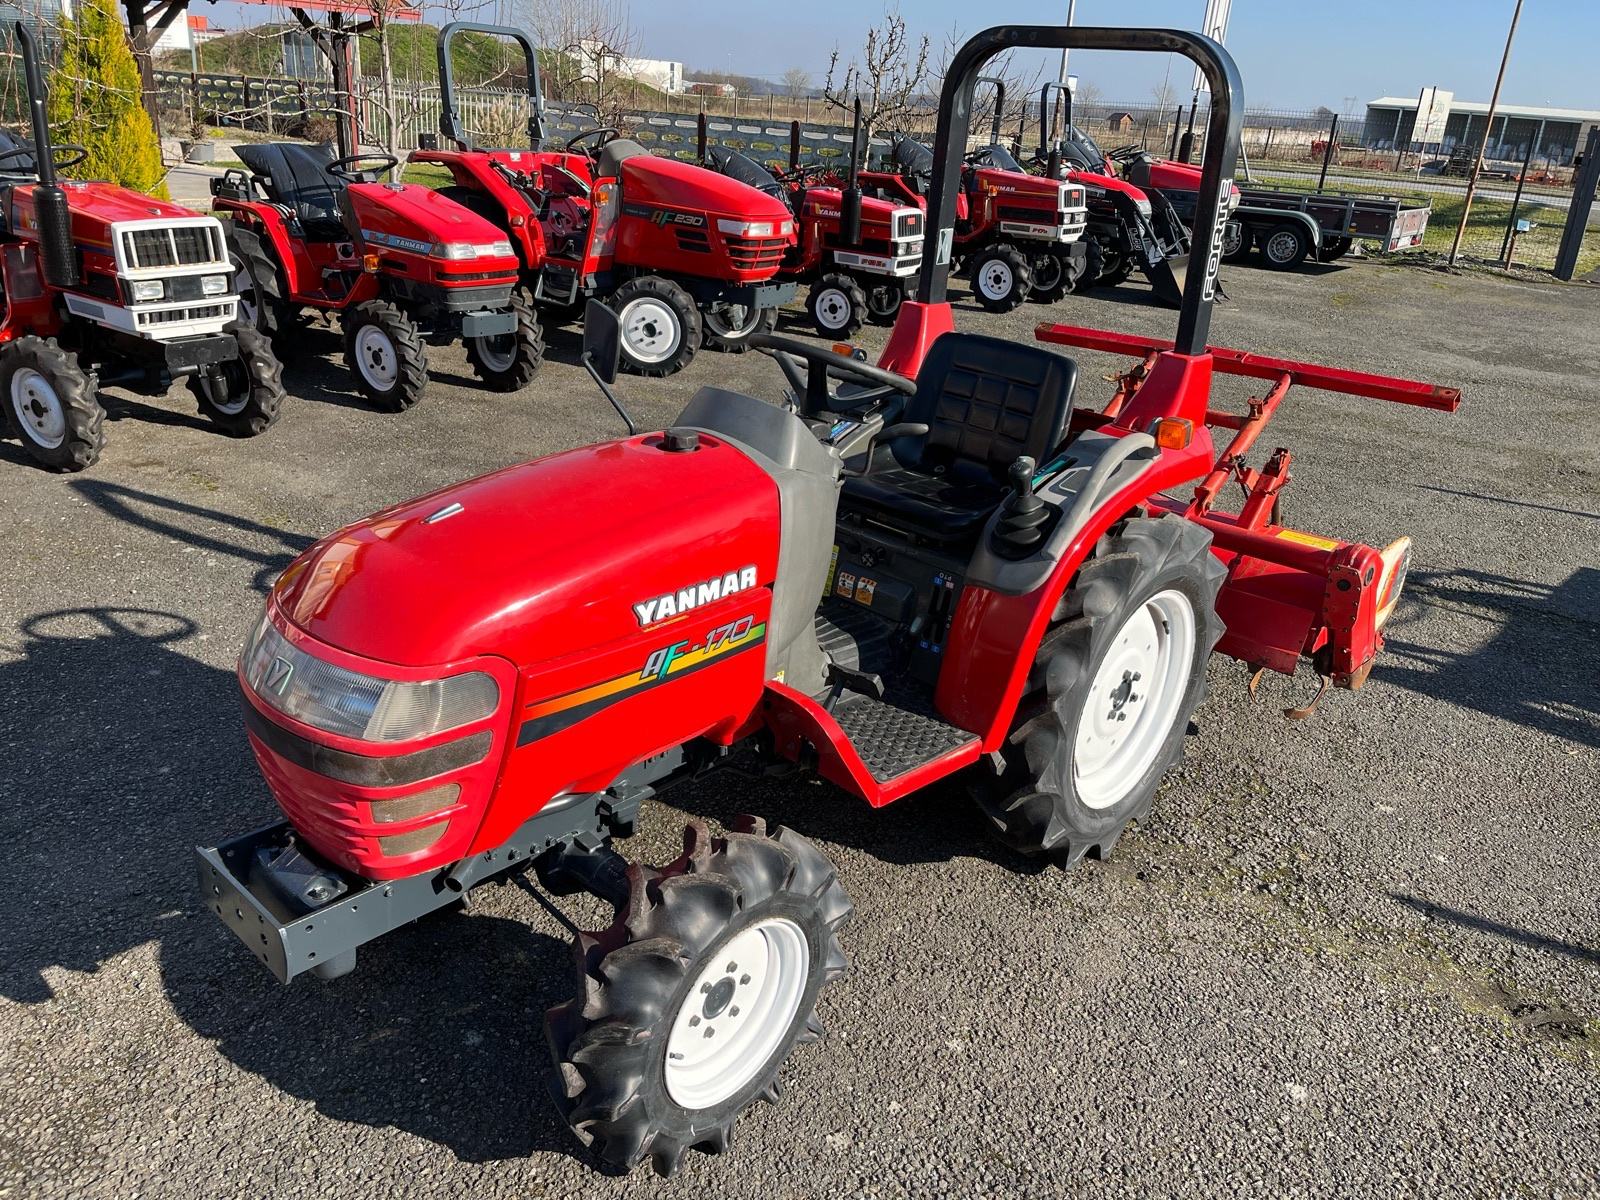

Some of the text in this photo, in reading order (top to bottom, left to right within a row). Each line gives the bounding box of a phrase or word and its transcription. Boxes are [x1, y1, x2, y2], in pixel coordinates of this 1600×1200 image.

[396, 239, 425, 251] YANMAR
[1203, 179, 1233, 301] FORTE
[631, 563, 757, 626] YANMAR
[639, 613, 755, 680] AF-170
